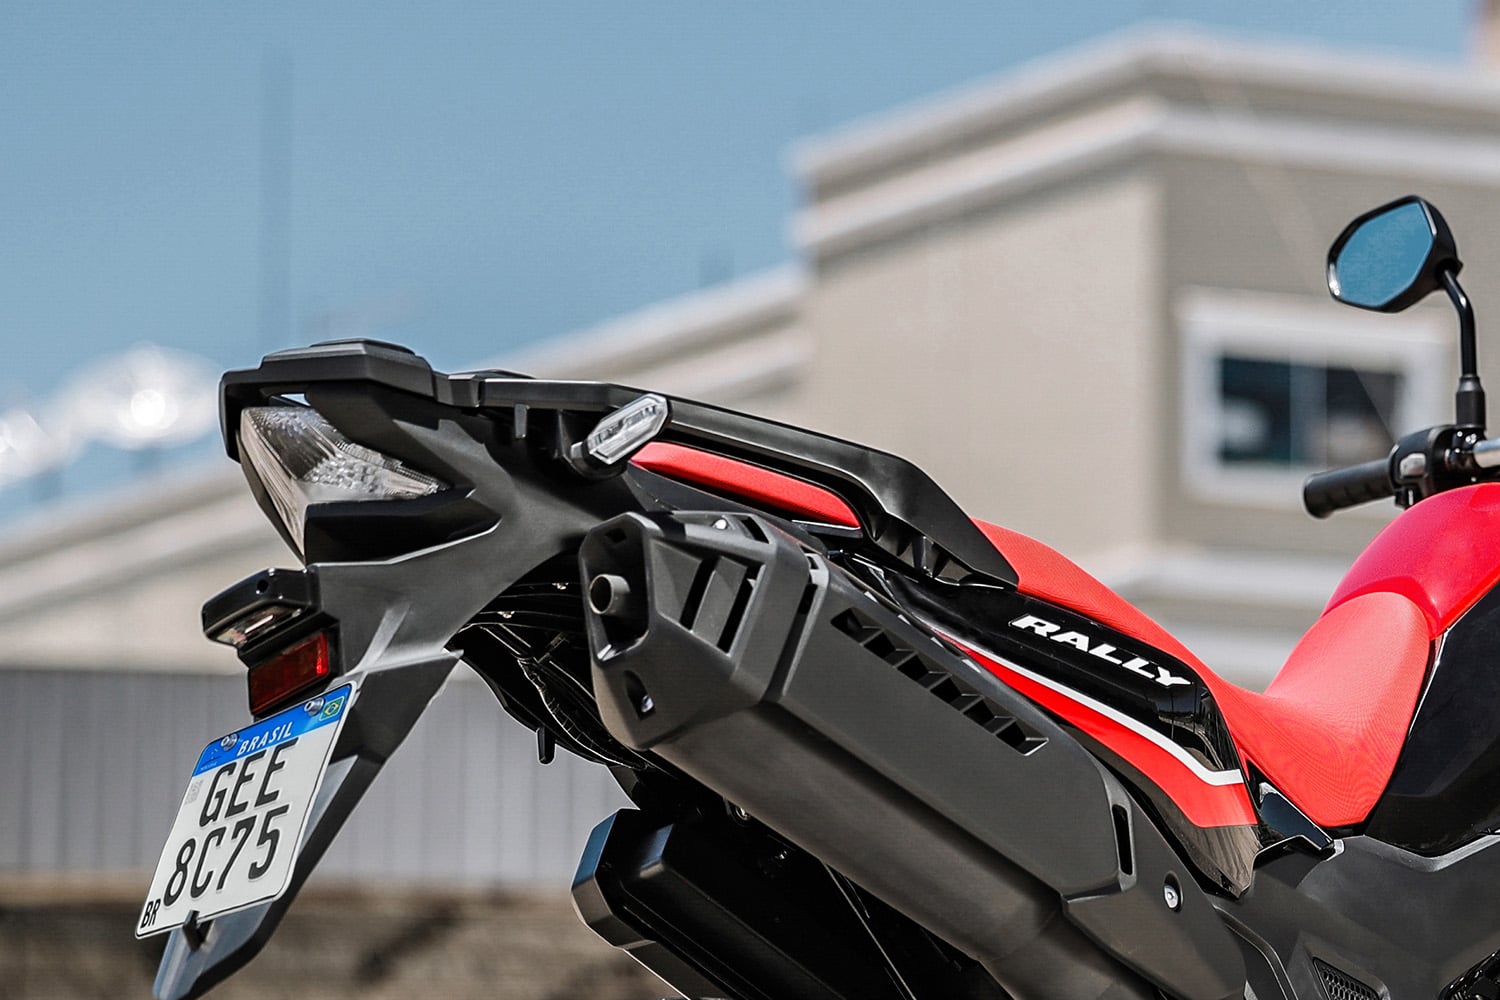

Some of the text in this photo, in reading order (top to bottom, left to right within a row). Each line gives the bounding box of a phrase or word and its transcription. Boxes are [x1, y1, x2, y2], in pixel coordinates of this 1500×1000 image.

[1009, 615, 1192, 687] RALLY
[236, 721, 292, 757] BRASIL
[199, 737, 300, 827] GEE
[163, 804, 290, 907] 8C75
[140, 898, 161, 929] BR
